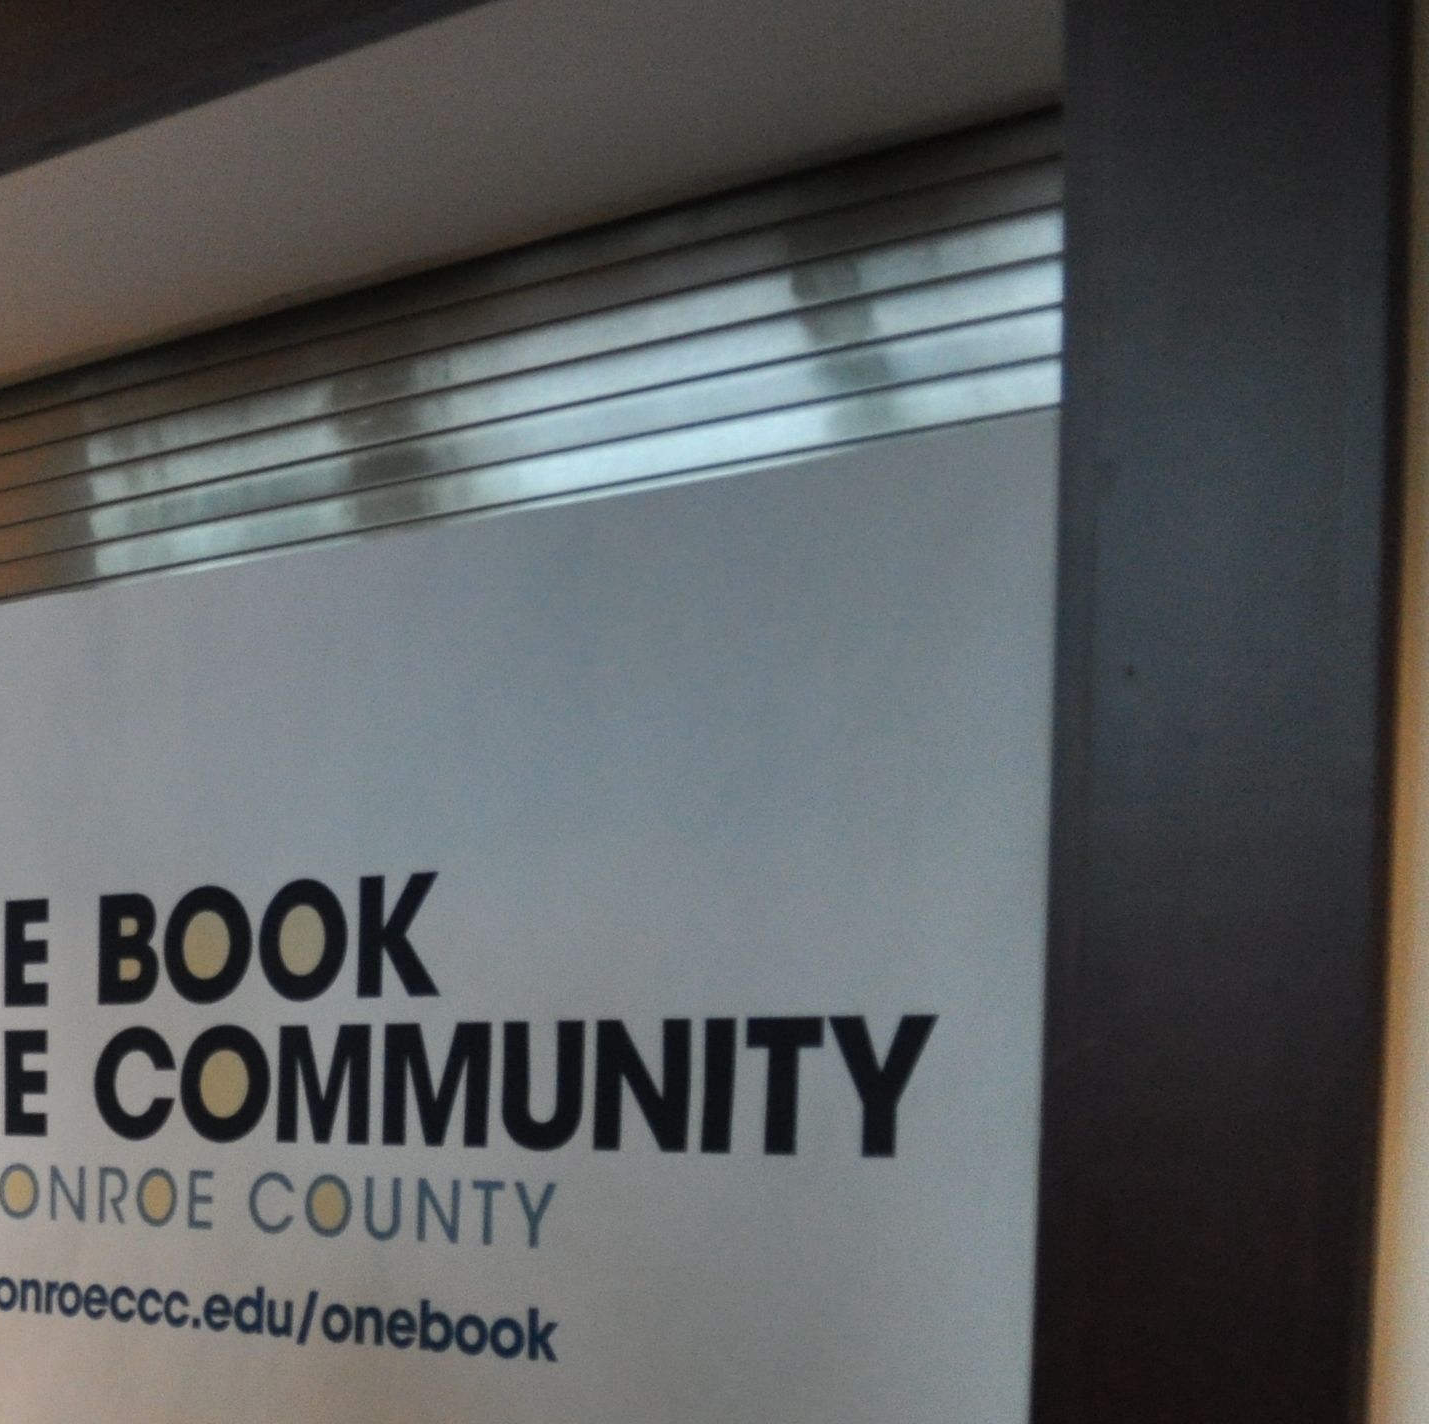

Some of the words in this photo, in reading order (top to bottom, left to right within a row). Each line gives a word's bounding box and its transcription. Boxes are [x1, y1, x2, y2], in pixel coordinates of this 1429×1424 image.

[97, 870, 441, 1006] BOOK
[93, 1012, 939, 1158] COMMUNITY
[247, 1170, 560, 1249] COUNTY
